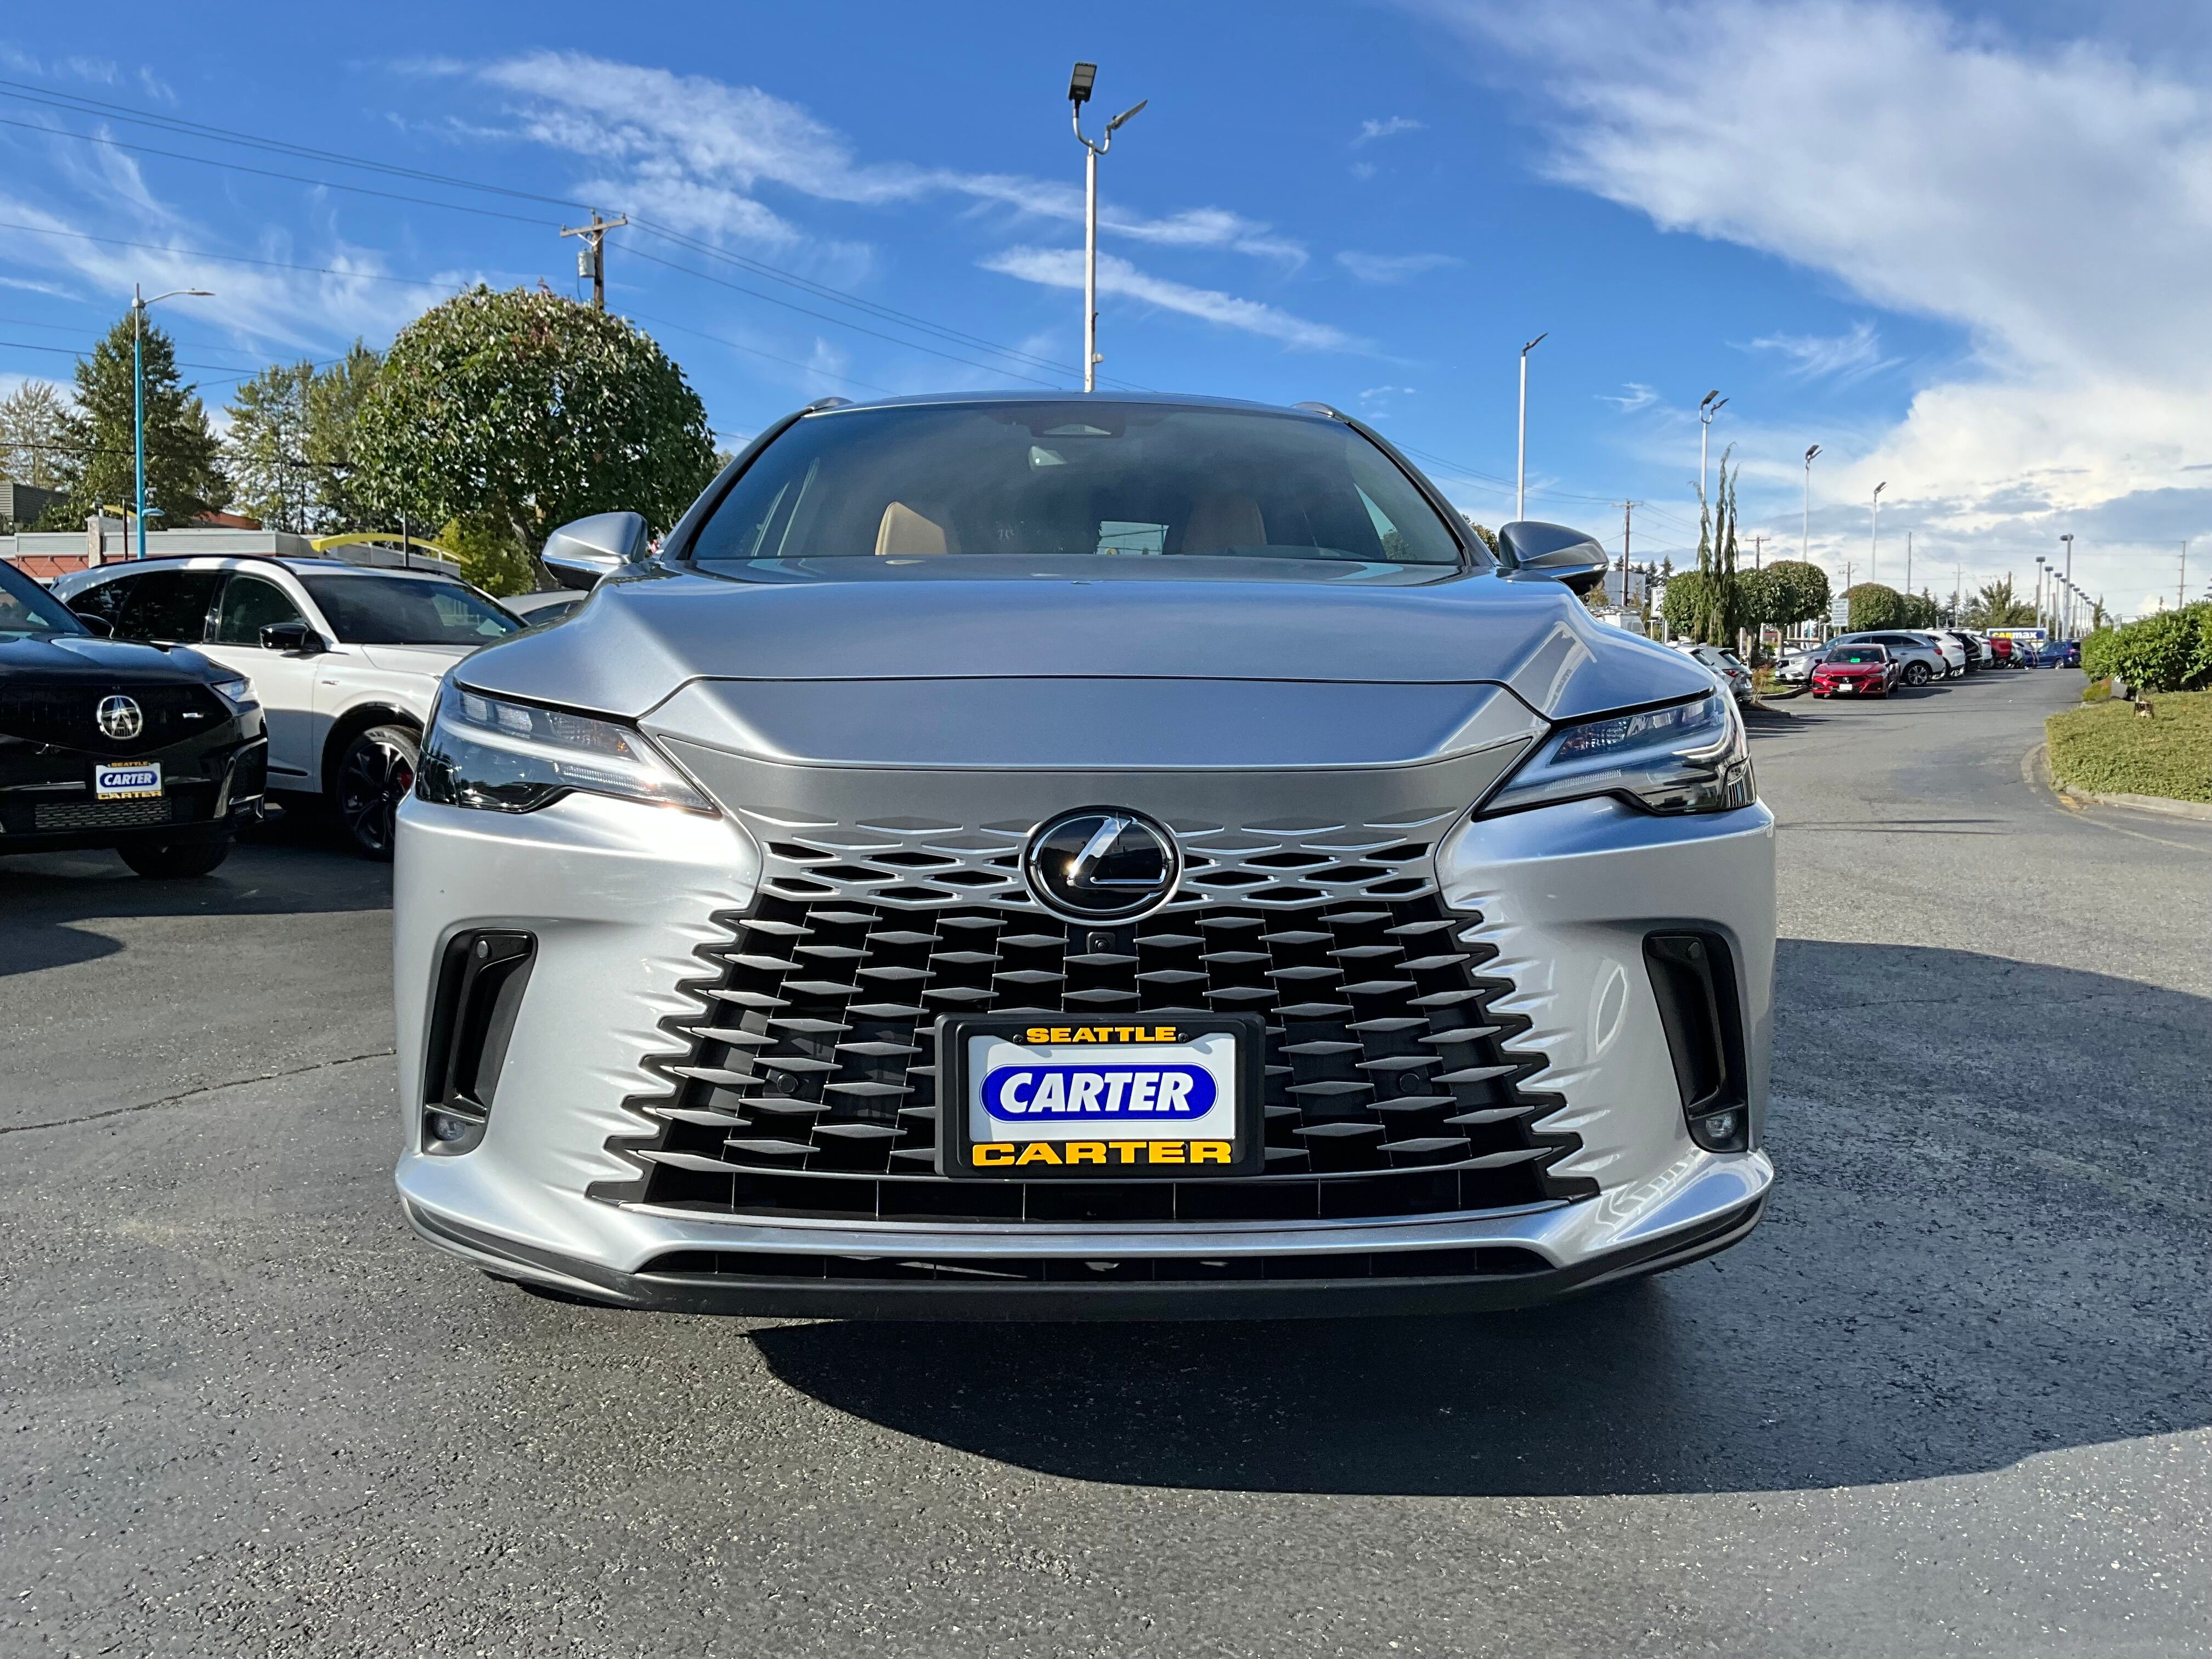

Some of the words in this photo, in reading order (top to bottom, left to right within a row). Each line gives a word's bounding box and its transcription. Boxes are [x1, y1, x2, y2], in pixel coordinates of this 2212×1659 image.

[104, 772, 153, 786] CARTER
[98, 790, 162, 800] CARTER
[1026, 1026, 1176, 1042] SEATTLE
[1000, 1072, 1194, 1113] CARTER
[972, 1141, 1231, 1166] CARTER
